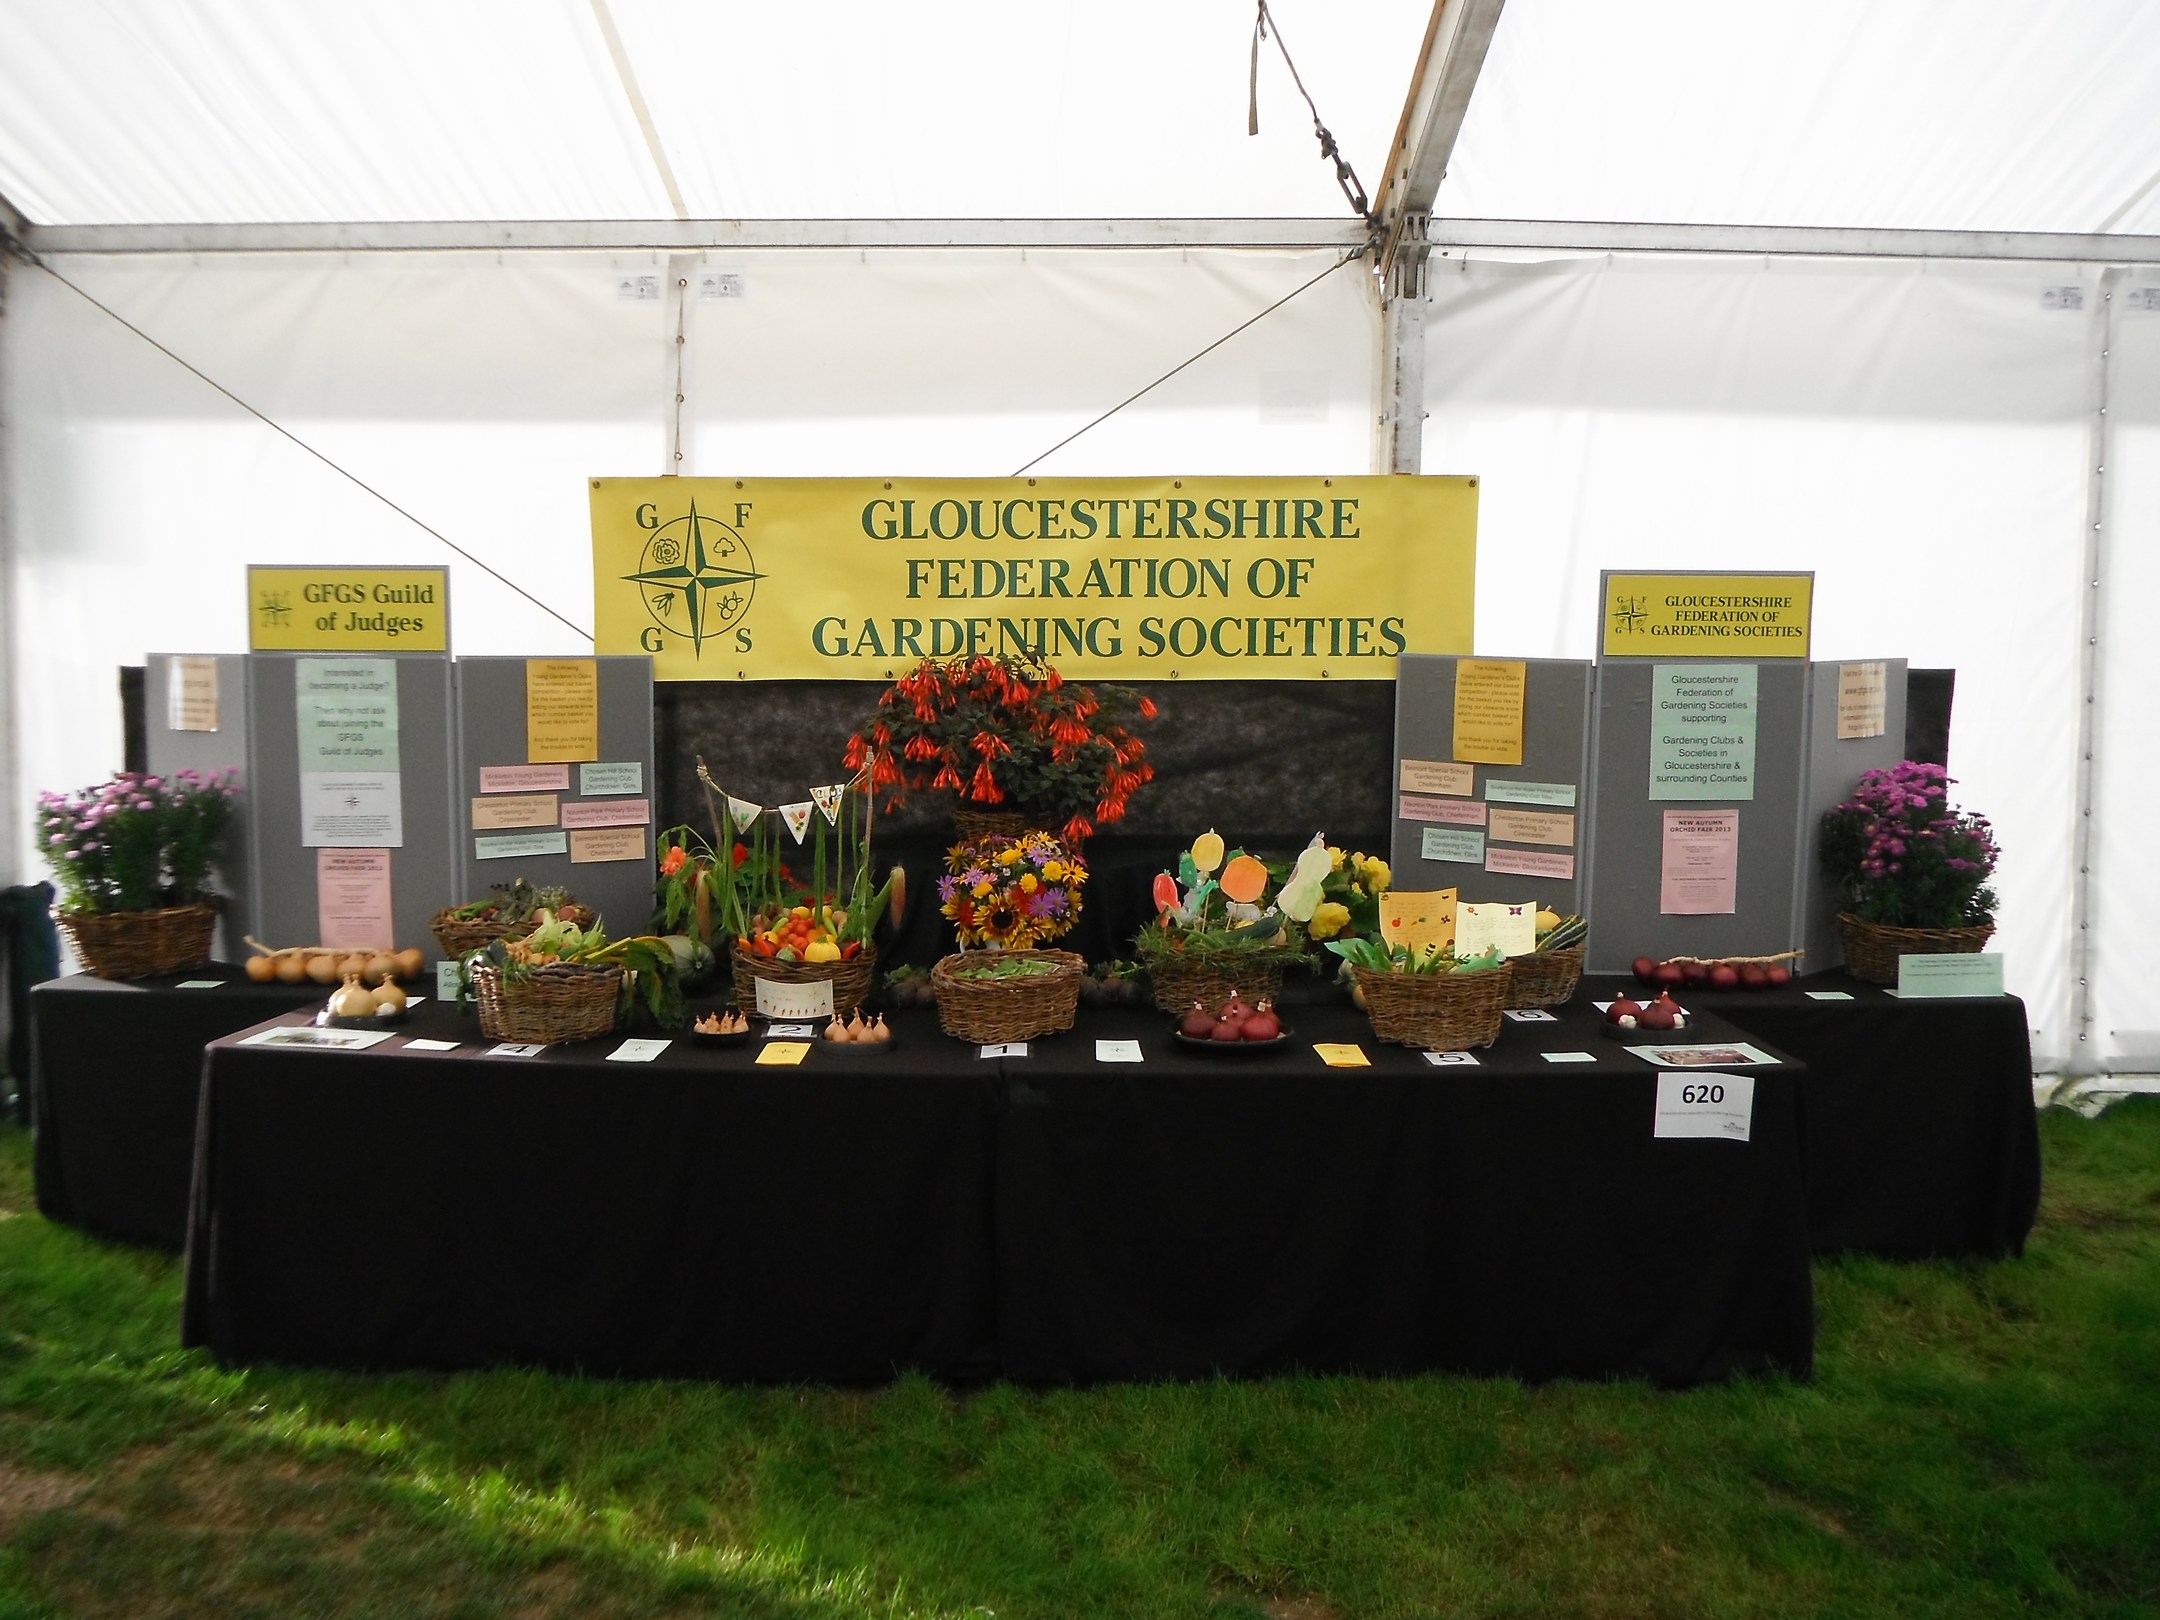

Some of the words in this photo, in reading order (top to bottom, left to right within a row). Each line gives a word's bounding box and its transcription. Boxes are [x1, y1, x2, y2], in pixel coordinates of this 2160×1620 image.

[636, 503, 659, 528] G
[735, 503, 752, 527] F
[861, 498, 1361, 540] GLOUCESTERSHIRE
[906, 557, 1230, 599] FEDERATION
[1247, 557, 1315, 598] OF
[304, 583, 365, 604] GFGS
[374, 584, 433, 604] Guild
[1666, 596, 1791, 607] GLOUCESTERSHIRE
[1676, 612, 1757, 622] FEDERATION
[1762, 612, 1779, 622] OF
[316, 612, 336, 630] of
[345, 612, 423, 636] Judges
[811, 616, 1122, 658] GARDENING
[1138, 616, 1407, 658] SOCIETIES
[1652, 625, 1730, 636] GARDENING
[1734, 627, 1802, 637] SOCIETIES
[641, 627, 664, 653] G
[736, 629, 752, 653] S
[1671, 676, 1738, 684] Gloucestershire
[1677, 688, 1722, 696] Federation
[1725, 688, 1733, 696] of
[1661, 701, 1706, 711] Gardening
[1709, 701, 1747, 709] Societies
[1682, 715, 1726, 723] supporting
[1663, 736, 1708, 745] Gardening
[1711, 736, 1735, 744] Clubs
[1679, 749, 1717, 757] Societies
[1720, 749, 1727, 757] in
[1665, 761, 1731, 769] Gloucestershire
[1657, 774, 1707, 783] surrounding
[1710, 774, 1747, 782] Counties
[1518, 1009, 1544, 1021] 6
[1439, 1052, 1463, 1064] 5
[1682, 1085, 1724, 1103] 620
